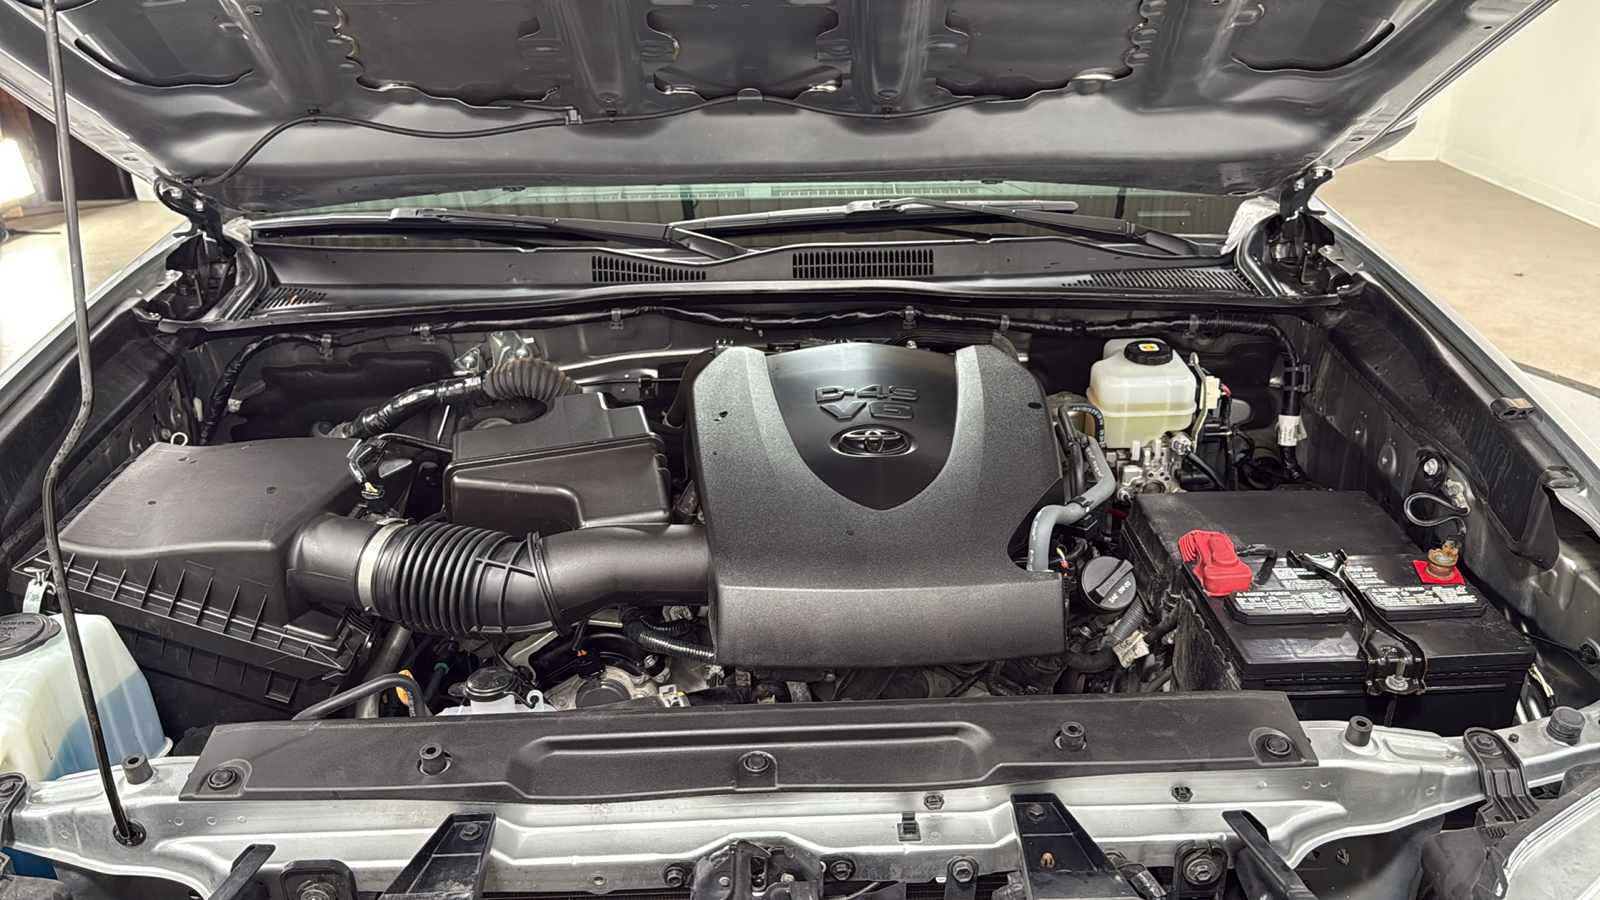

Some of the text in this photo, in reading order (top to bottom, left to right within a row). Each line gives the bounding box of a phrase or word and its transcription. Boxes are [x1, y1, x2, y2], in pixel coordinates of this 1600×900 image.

[815, 384, 919, 404] D-4S
[819, 401, 915, 422] V6
[1108, 592, 1119, 604] SAE
